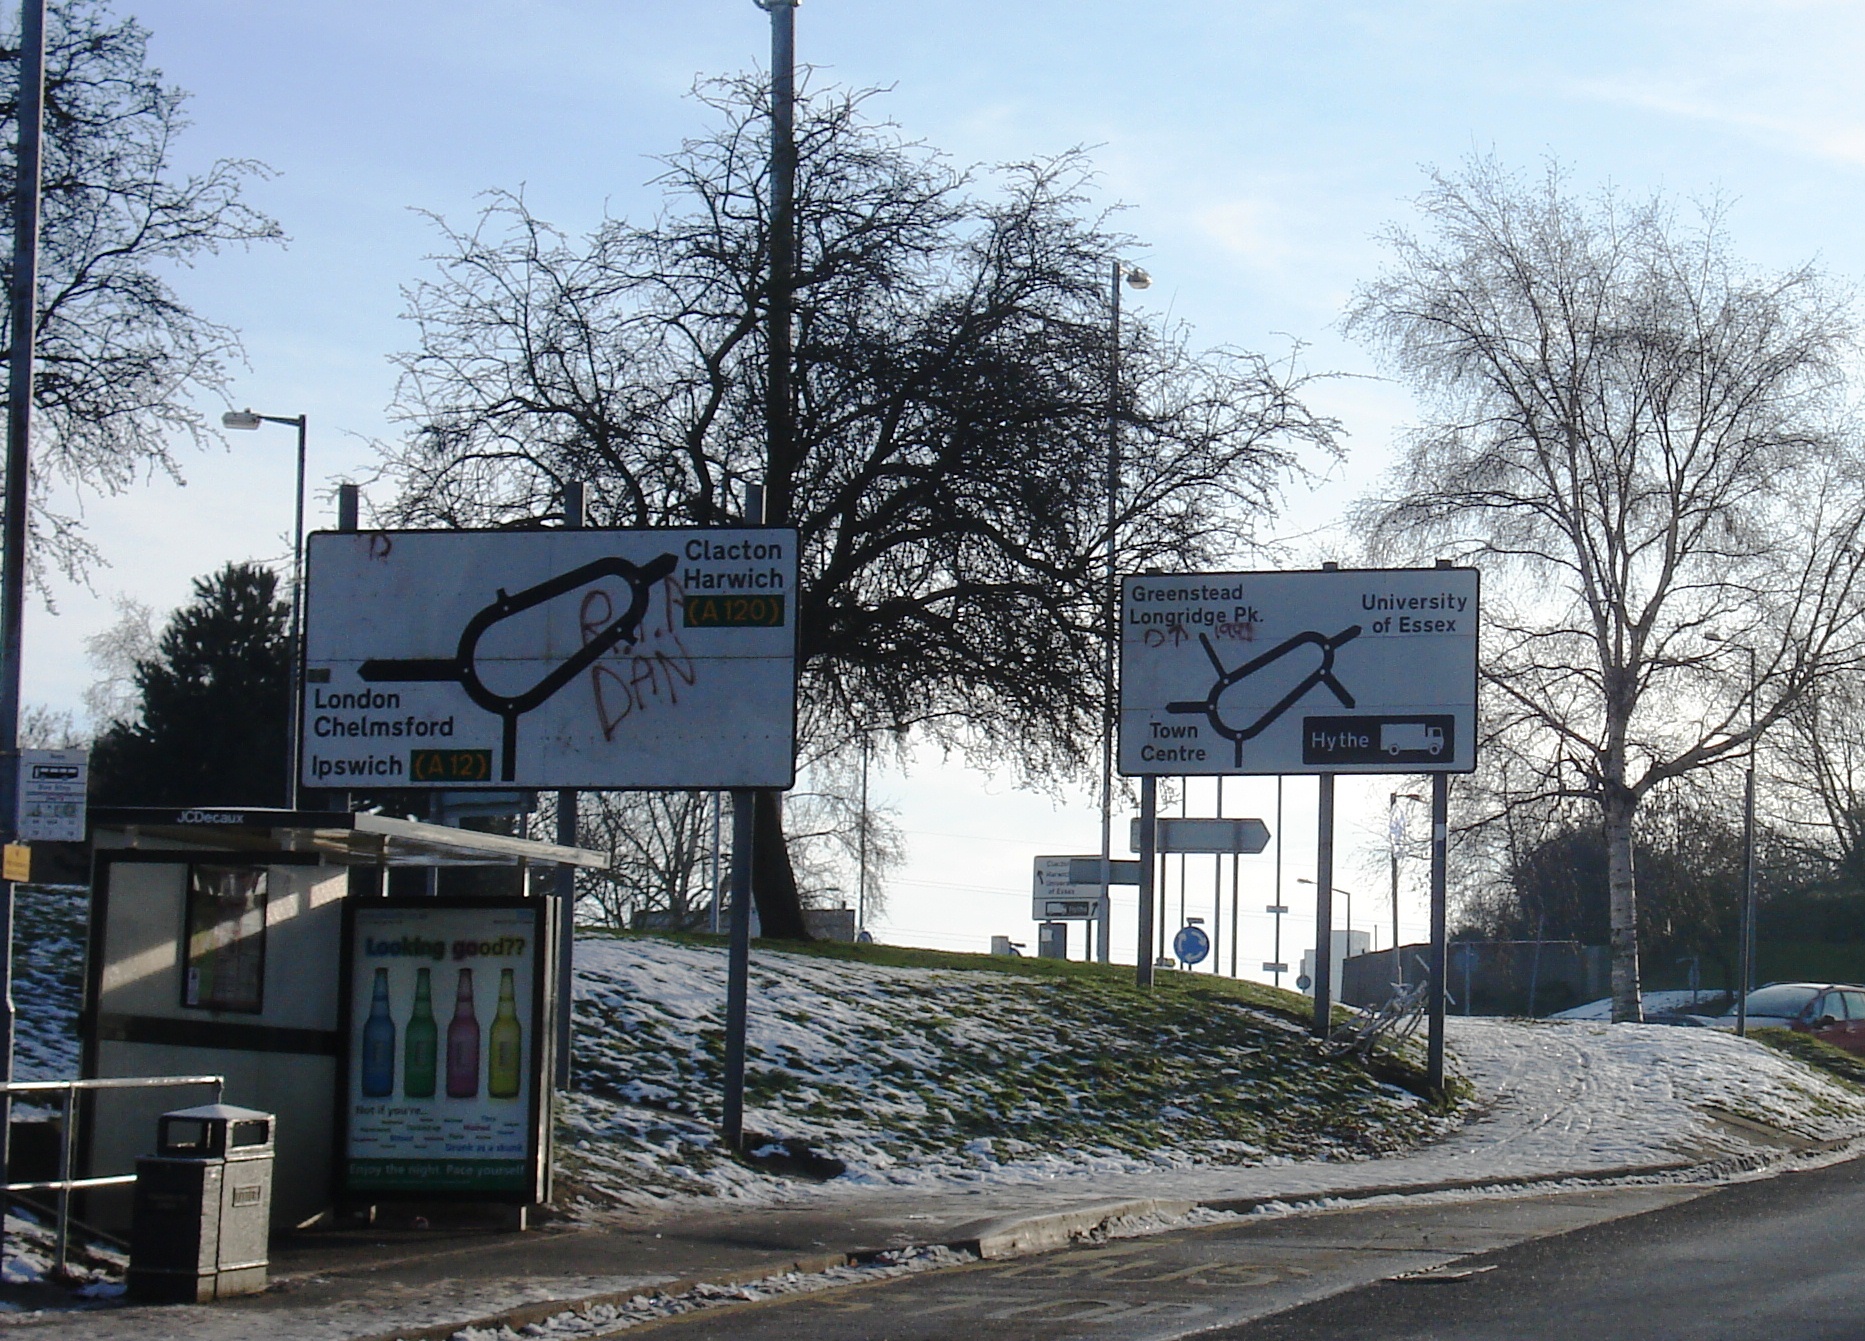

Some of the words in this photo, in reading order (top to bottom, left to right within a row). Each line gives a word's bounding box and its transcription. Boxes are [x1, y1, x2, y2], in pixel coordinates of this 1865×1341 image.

[685, 539, 783, 560] Clacton
[684, 567, 783, 589] Harwich
[1132, 584, 1243, 602] Greenstead
[1362, 593, 1468, 614] University
[1130, 608, 1227, 626] Longridge
[1234, 606, 1264, 623] Pk.
[1373, 617, 1391, 634] of
[1398, 617, 1456, 633] Essex
[315, 688, 400, 709] London
[592, 634, 696, 742] DAN
[314, 716, 454, 737] Chelmsford
[1150, 722, 1198, 739] Town
[1312, 731, 1370, 751] Hythe
[1141, 745, 1206, 762] Centre
[312, 755, 403, 779] Ipswich
[177, 810, 244, 823] JCDecaux
[365, 935, 445, 961] Looking
[452, 936, 526, 962] good??
